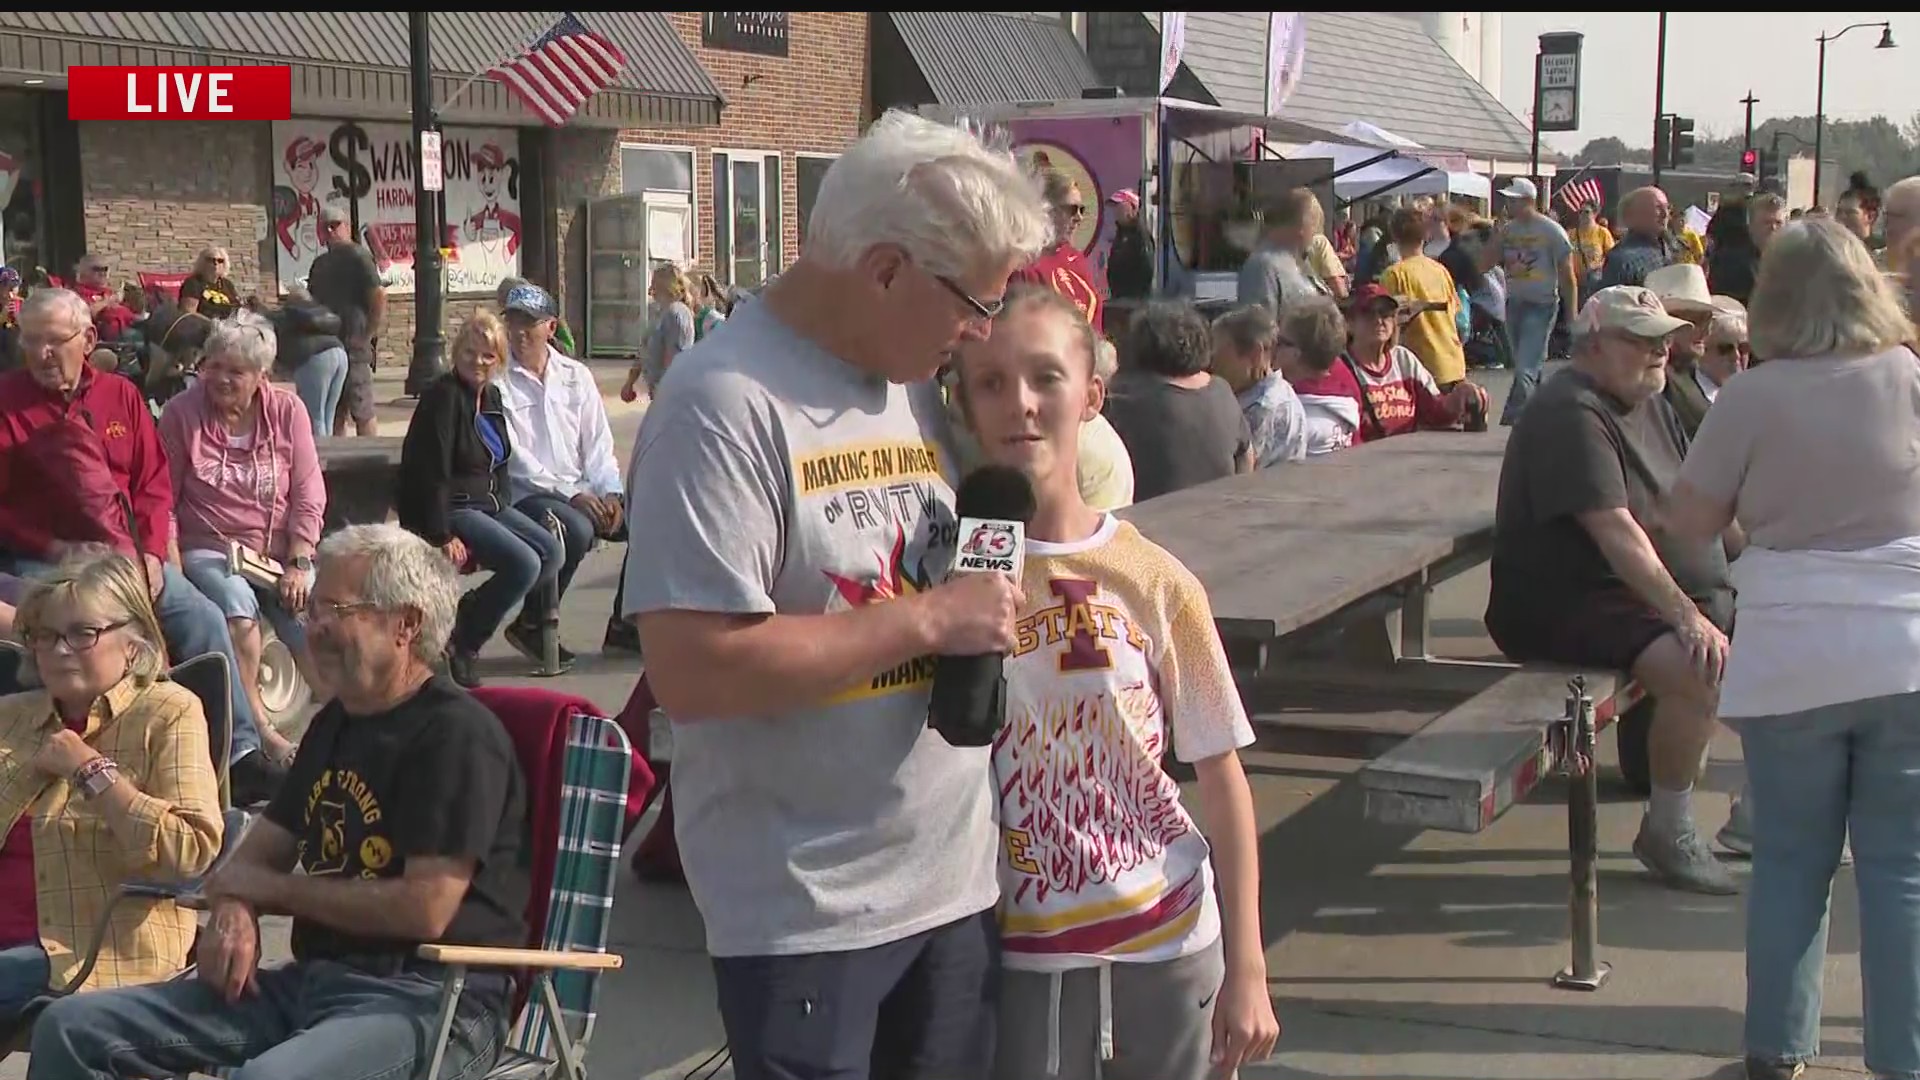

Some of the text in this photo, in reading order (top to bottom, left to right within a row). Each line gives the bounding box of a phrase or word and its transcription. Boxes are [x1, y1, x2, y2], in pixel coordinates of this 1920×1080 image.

[329, 123, 472, 199] SWANON
[376, 187, 416, 210] HARDW
[803, 450, 869, 490] MAKING
[872, 447, 894, 479] AN
[824, 480, 938, 531] ON RVTV
[960, 557, 1014, 572] NEWS
[1013, 602, 1146, 657] STATE
[871, 654, 936, 690] MANS
[337, 769, 382, 824] STRONG
